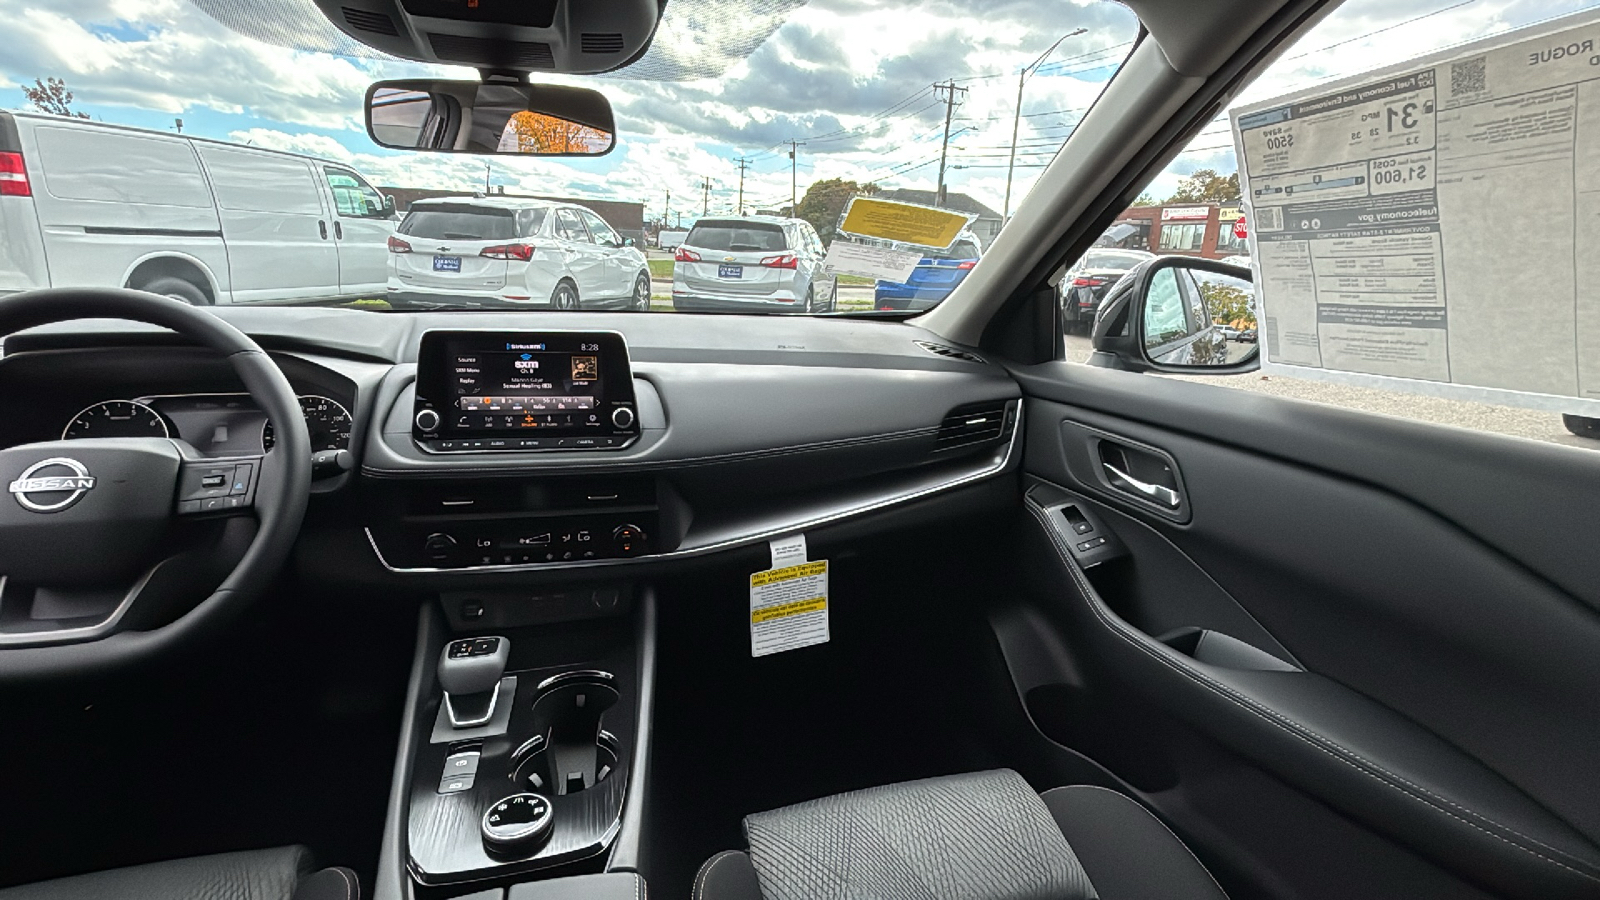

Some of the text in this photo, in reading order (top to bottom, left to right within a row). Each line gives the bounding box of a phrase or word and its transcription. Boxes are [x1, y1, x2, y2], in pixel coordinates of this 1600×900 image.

[581, 343, 599, 351] 8:28
[514, 360, 539, 369] sxm
[10, 480, 94, 489] NISSAN
[577, 533, 590, 542] Lo
[477, 538, 491, 547] Lo
[768, 569, 789, 578] Vehicle
[798, 561, 826, 572] Equipped
[753, 578, 766, 586] with
[768, 573, 798, 583] Advanced
[809, 568, 826, 576] Bags
